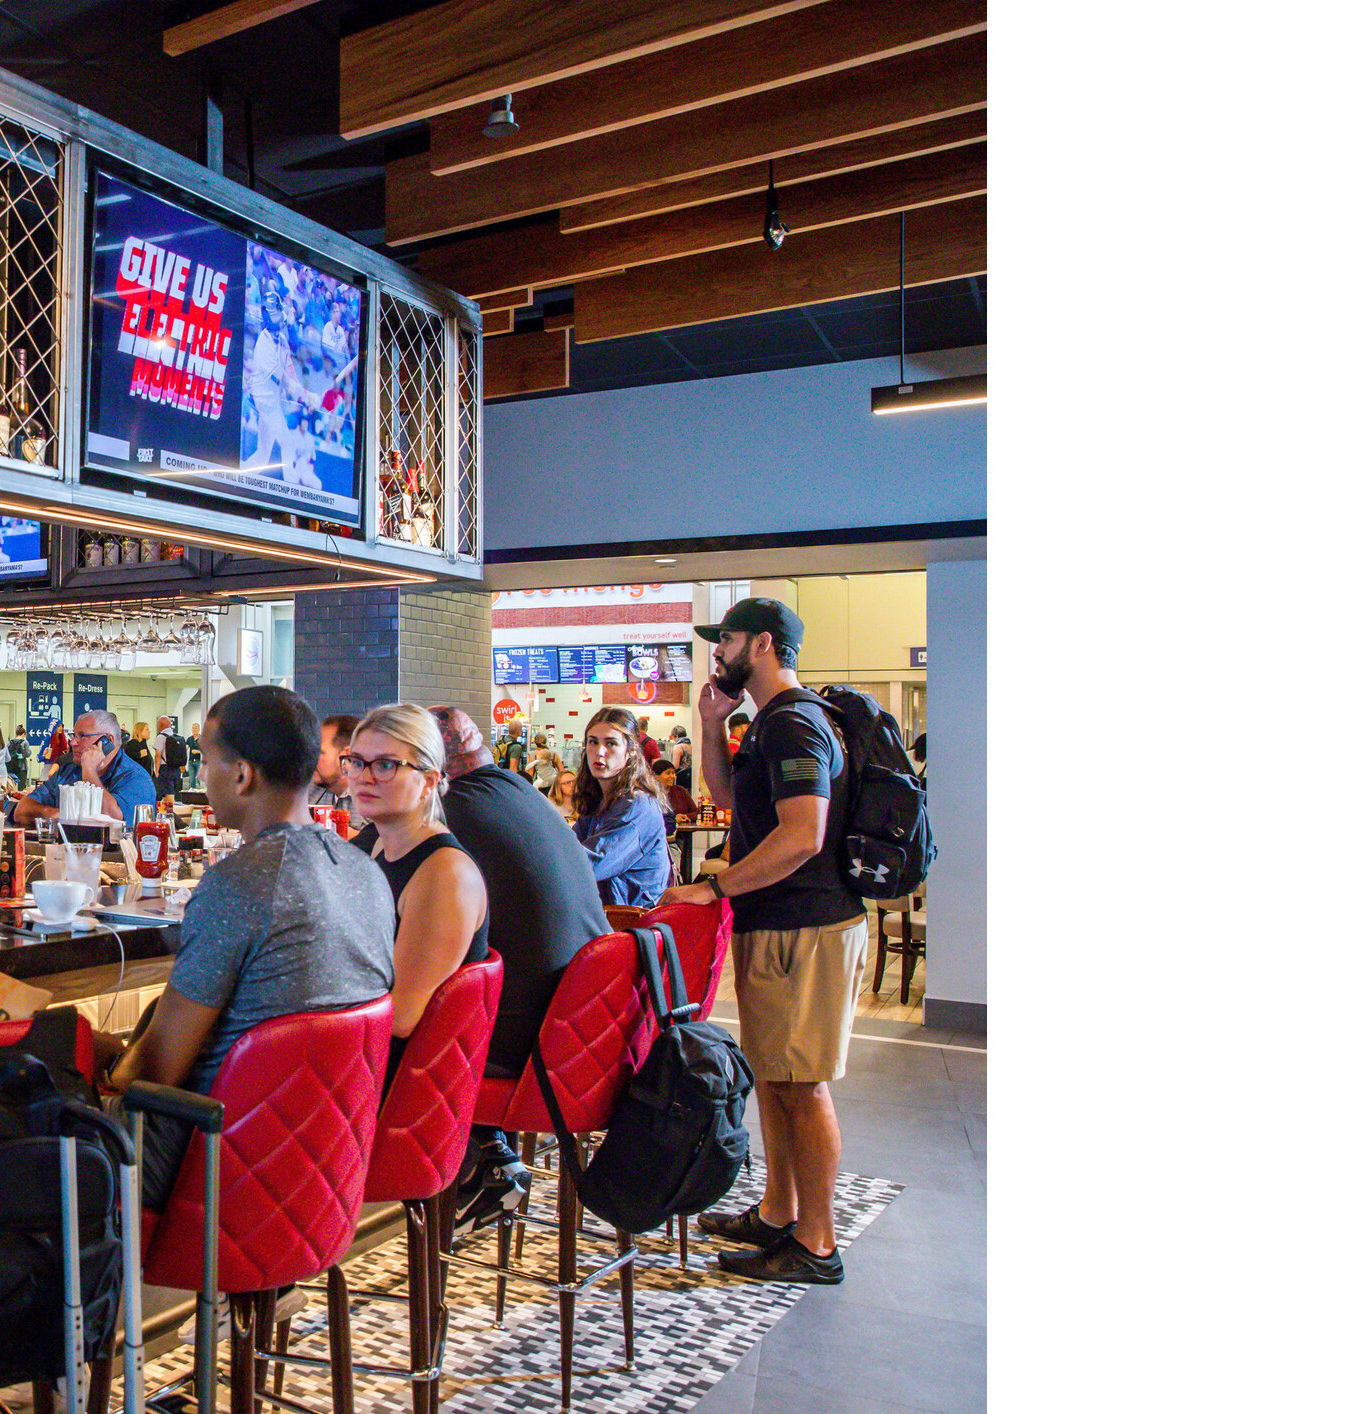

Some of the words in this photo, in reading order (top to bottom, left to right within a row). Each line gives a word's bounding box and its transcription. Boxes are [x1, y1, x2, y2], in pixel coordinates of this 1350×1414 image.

[120, 236, 191, 301] GIVE
[192, 263, 229, 315] US
[118, 302, 232, 378] ELECTRIC
[130, 358, 225, 420] MOMENTS
[166, 456, 196, 472] COMING
[245, 476, 268, 490] TOUGHEST
[291, 488, 300, 498] FOR
[623, 632, 641, 640] treat
[642, 631, 671, 641] yourself
[672, 631, 687, 639] well
[32, 681, 58, 691] Re-Pack
[78, 684, 103, 693] Re-Dress
[496, 704, 518, 715] swirl
